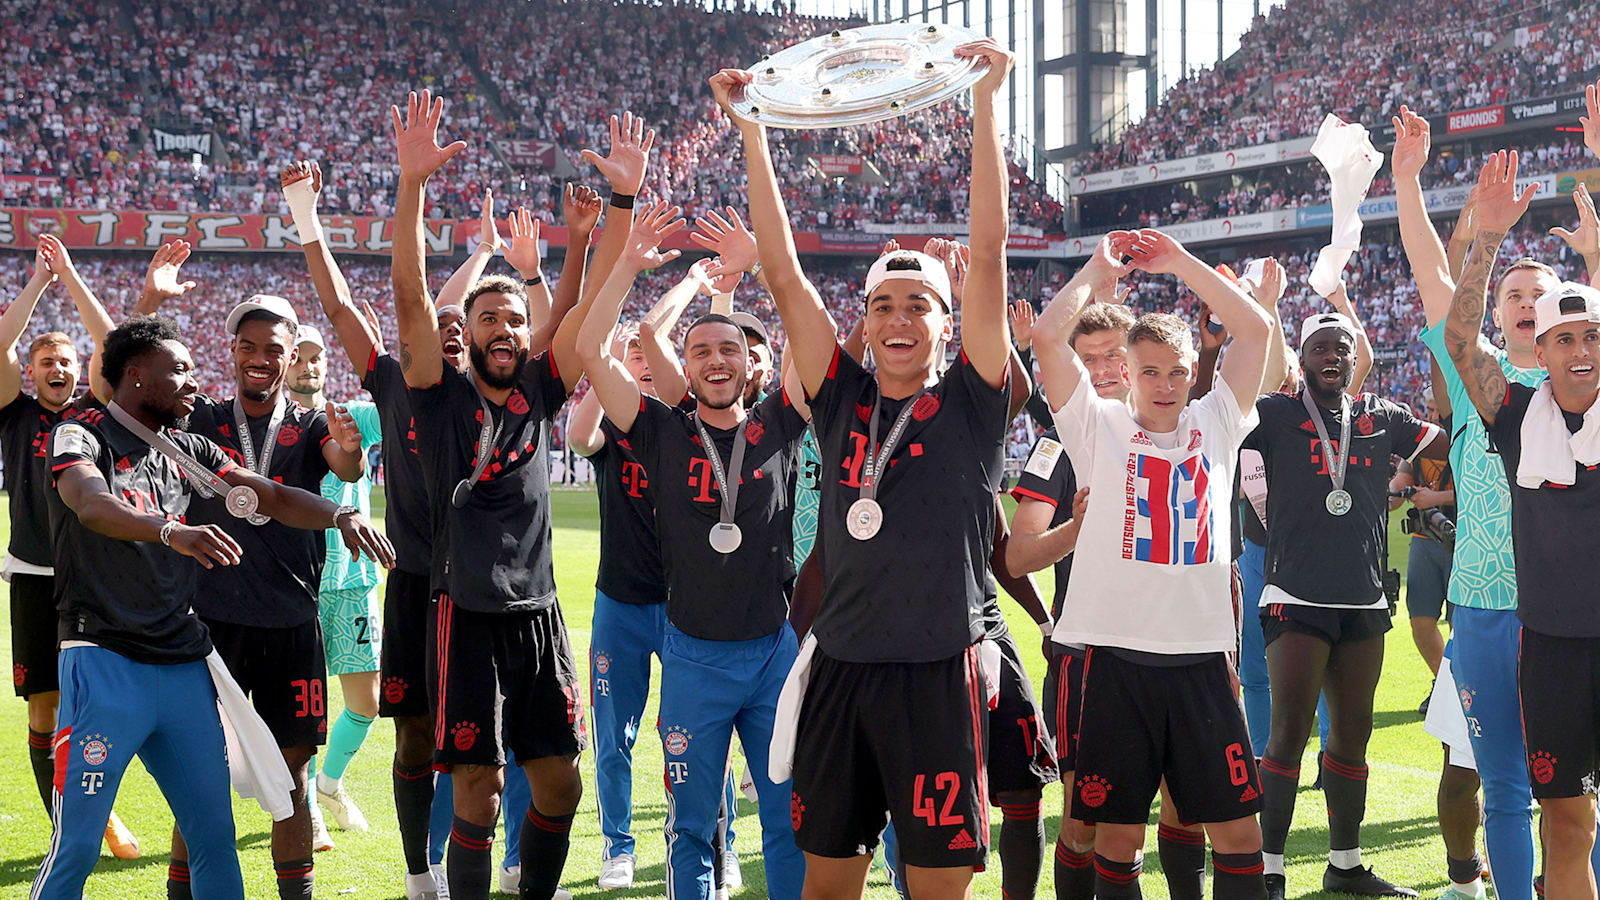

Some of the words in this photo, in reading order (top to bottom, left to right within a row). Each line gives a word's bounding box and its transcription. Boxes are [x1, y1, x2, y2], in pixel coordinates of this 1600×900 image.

[1523, 101, 1556, 116] hummel
[153, 129, 211, 156] TROIKA
[240, 422, 256, 472] BUNDESLIGA
[1130, 437, 1152, 446] adidas
[175, 453, 213, 482] BUNDESLIGA
[1122, 508, 1136, 560] DEUTSCHER
[354, 616, 379, 645] 26
[291, 678, 325, 717] 38
[1225, 742, 1248, 786] 6
[913, 771, 964, 826] 42
